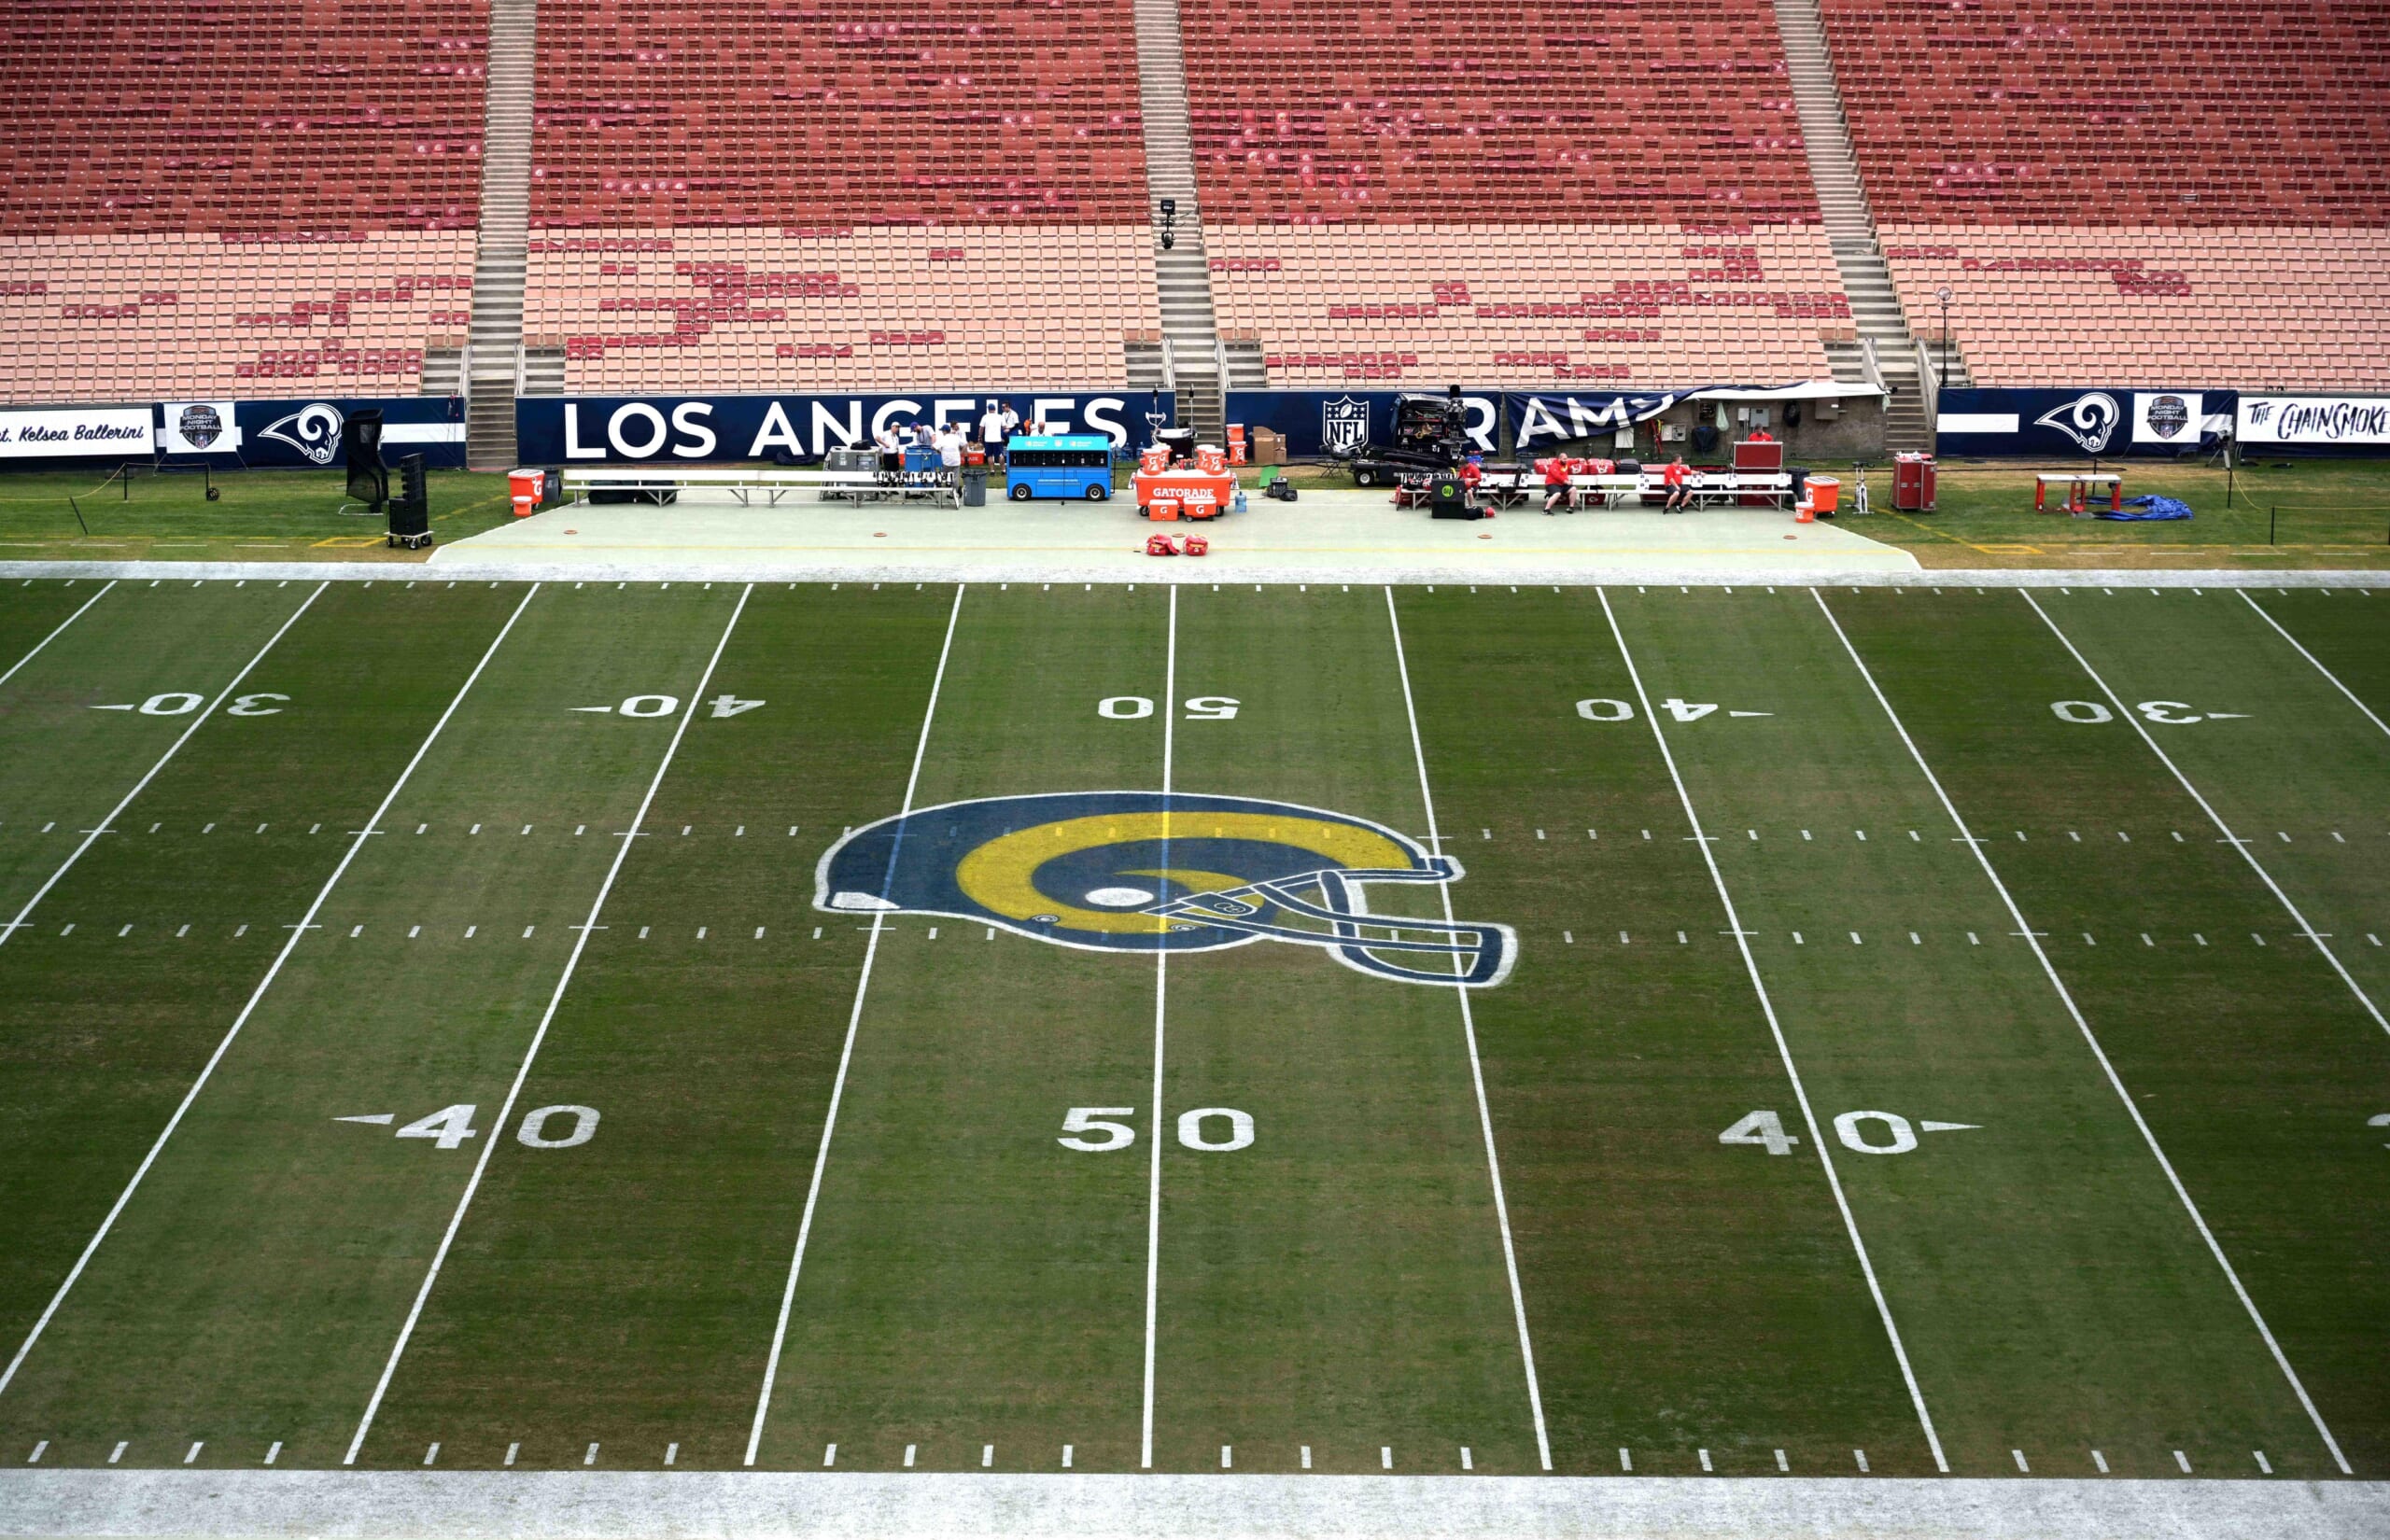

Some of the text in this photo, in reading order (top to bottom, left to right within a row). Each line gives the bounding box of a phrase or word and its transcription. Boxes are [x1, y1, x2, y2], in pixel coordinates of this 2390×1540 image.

[2246, 401, 2275, 426] THE
[19, 426, 69, 442] Kelsea
[74, 424, 144, 441] Ballerini
[564, 398, 1128, 458] LOS ANGEES
[1329, 421, 1364, 445] NFL
[1153, 487, 1215, 497] GATORADE
[1160, 506, 1168, 514] G
[1195, 505, 1204, 514] G
[395, 1104, 600, 1148] 40
[1057, 1107, 1255, 1152] 50
[1719, 1111, 1918, 1155] 40
